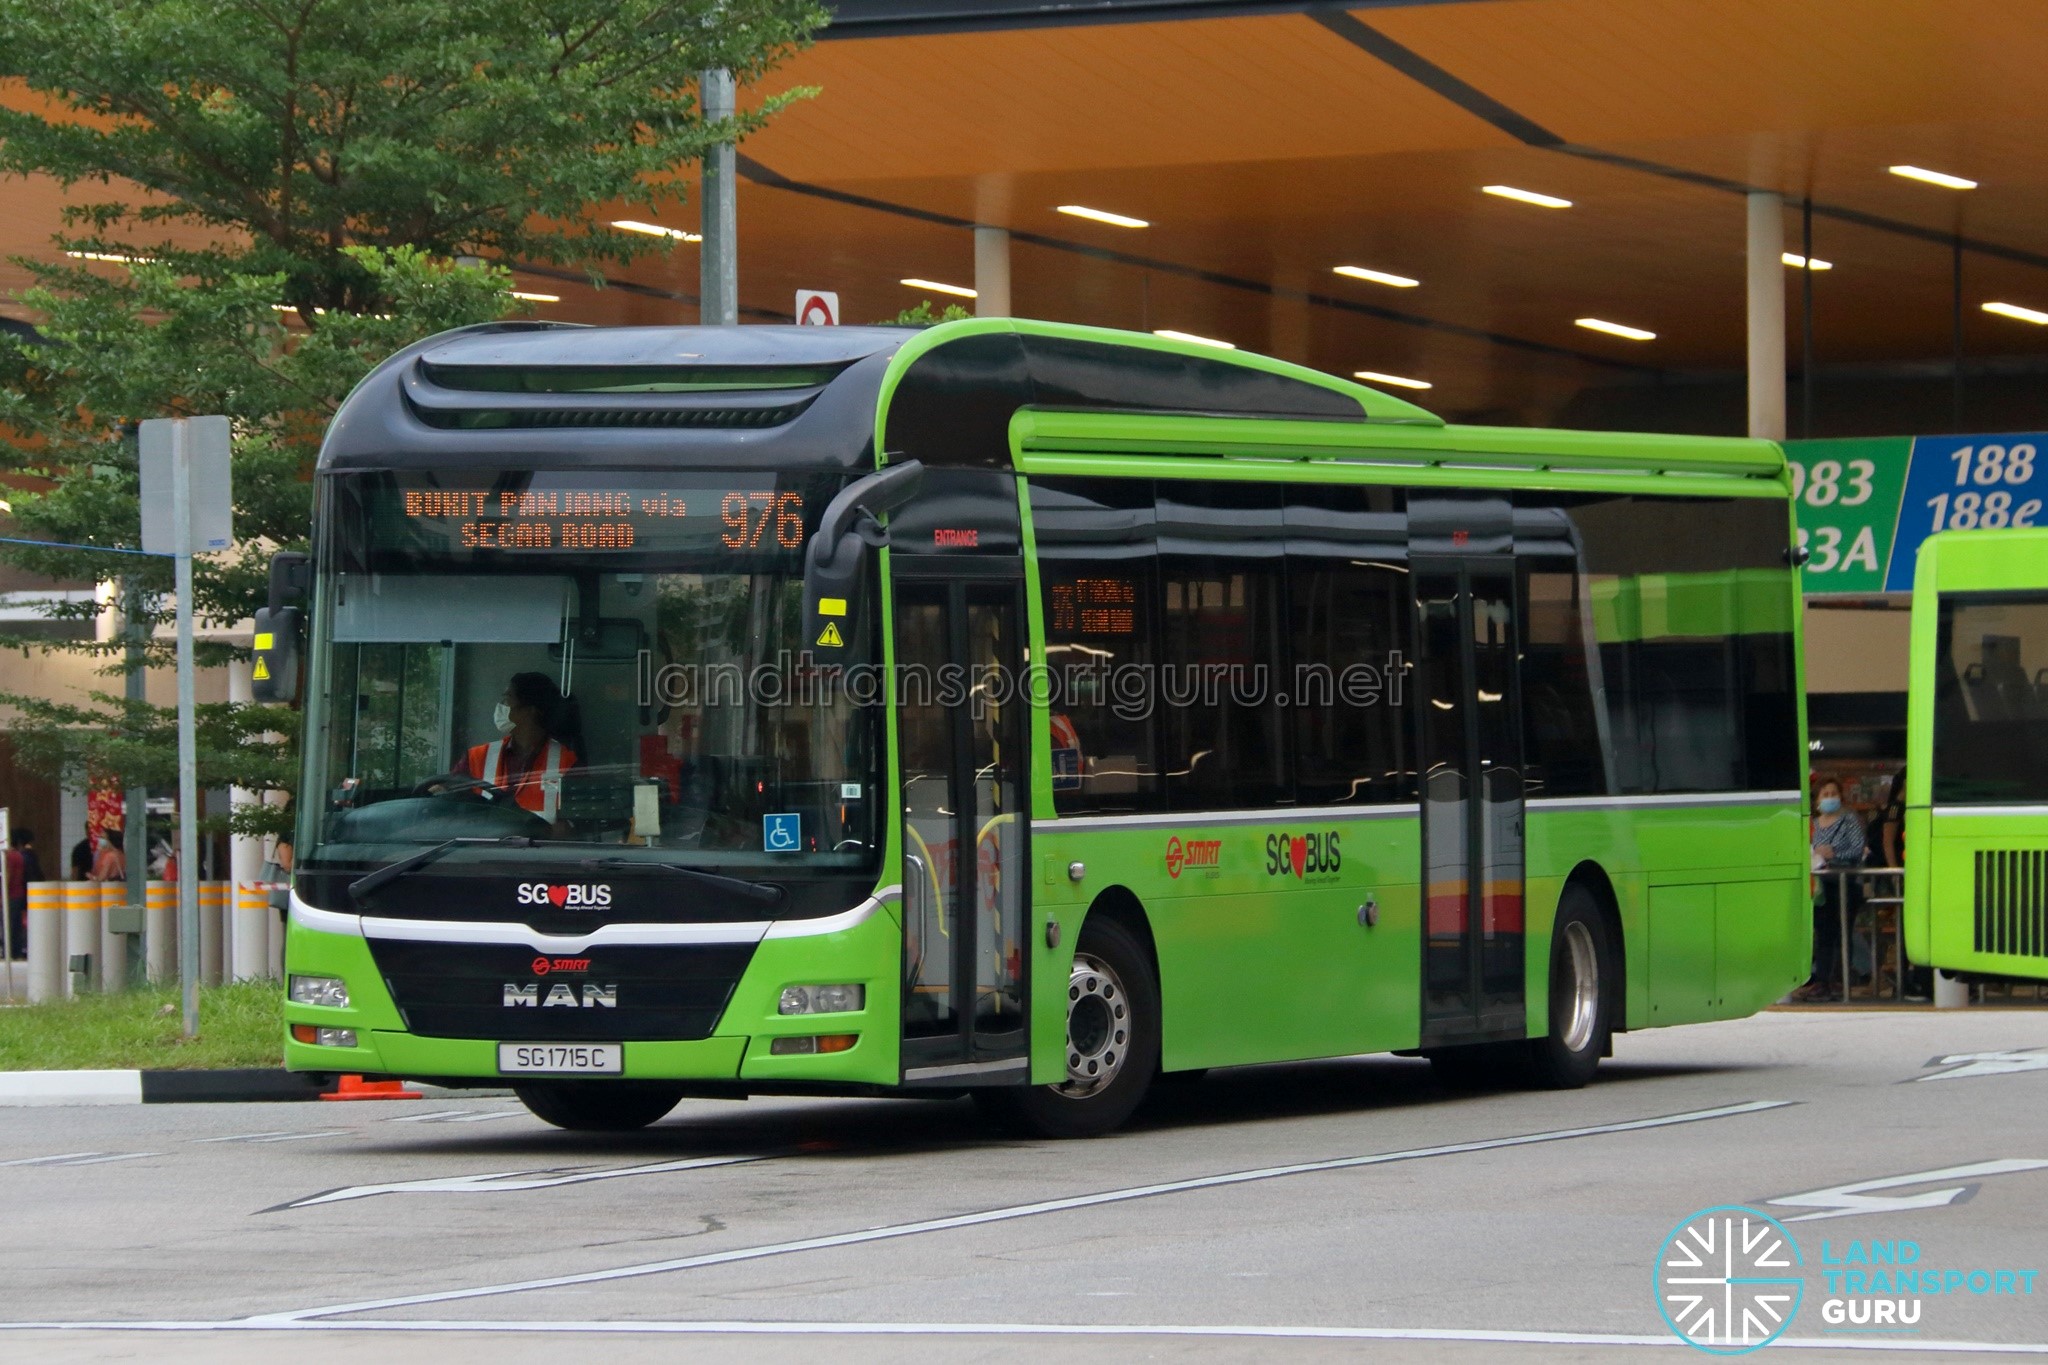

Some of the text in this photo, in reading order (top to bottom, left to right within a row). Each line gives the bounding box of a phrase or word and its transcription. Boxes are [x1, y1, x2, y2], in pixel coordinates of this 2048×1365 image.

[1950, 443, 2038, 487] 188
[405, 492, 687, 518] BUKIT PANJANG via
[1926, 490, 2043, 533] 188e
[721, 492, 803, 549] 976
[460, 523, 634, 548] SEGAR ROAD
[934, 529, 978, 547] ENTRANCE
[1184, 840, 1222, 865] SMRT
[551, 959, 591, 971] SMRT
[503, 983, 618, 1008] MAN
[517, 1048, 605, 1068] SG1715C
